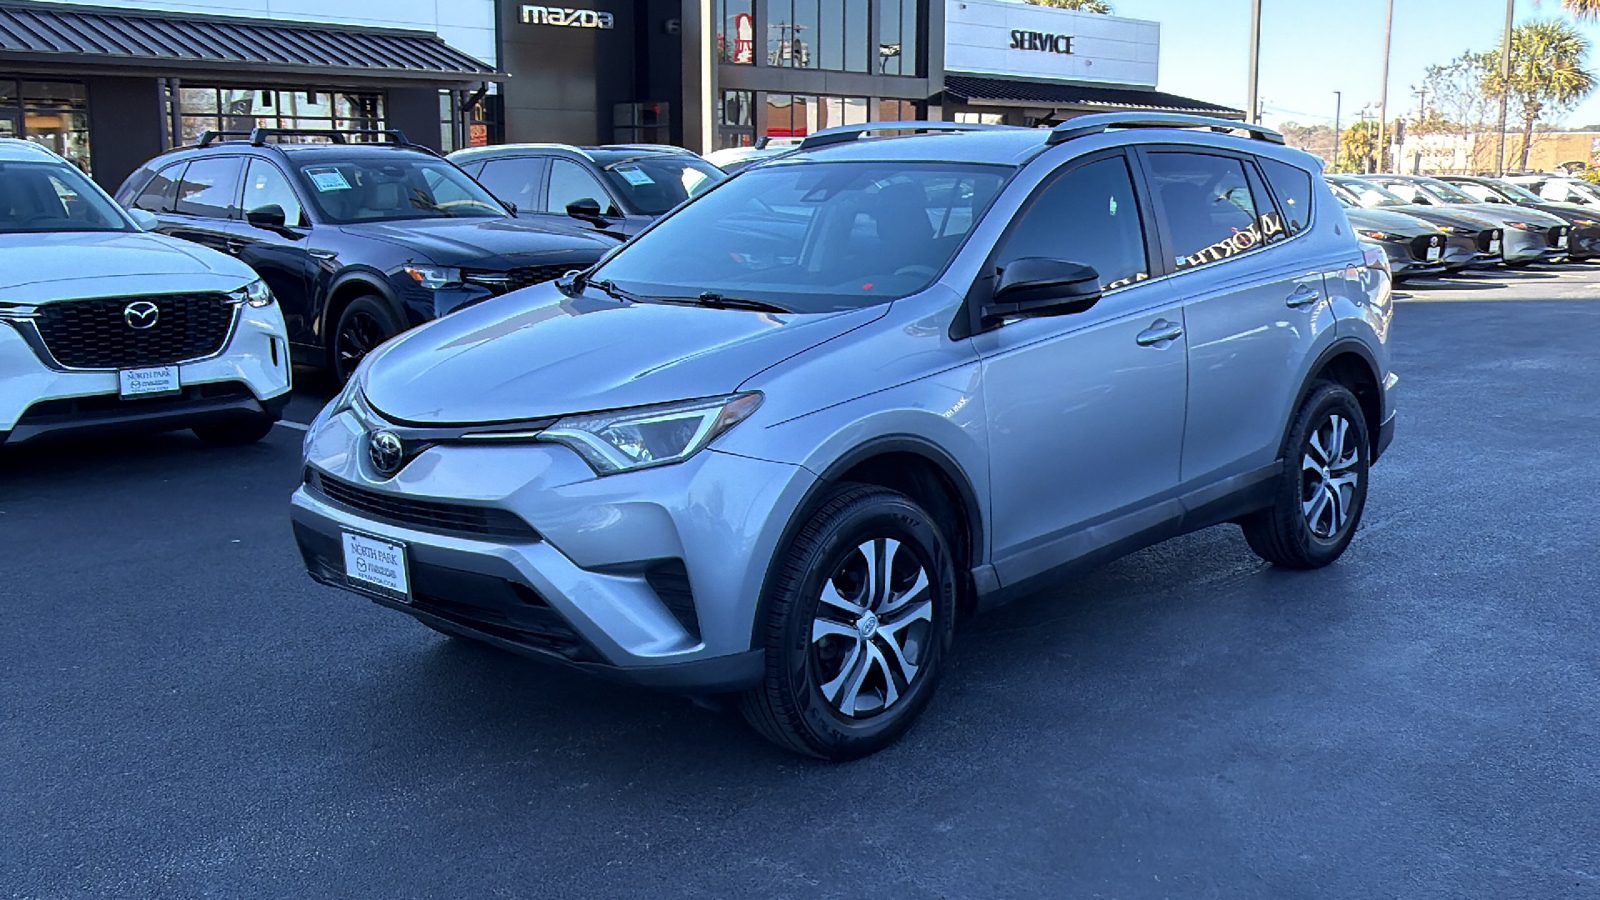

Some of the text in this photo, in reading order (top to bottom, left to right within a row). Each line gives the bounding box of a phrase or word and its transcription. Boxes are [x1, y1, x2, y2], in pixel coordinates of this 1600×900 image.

[519, 4, 614, 29] mazda
[1009, 29, 1075, 55] SERVICE
[351, 543, 398, 566] NORTH PARK
